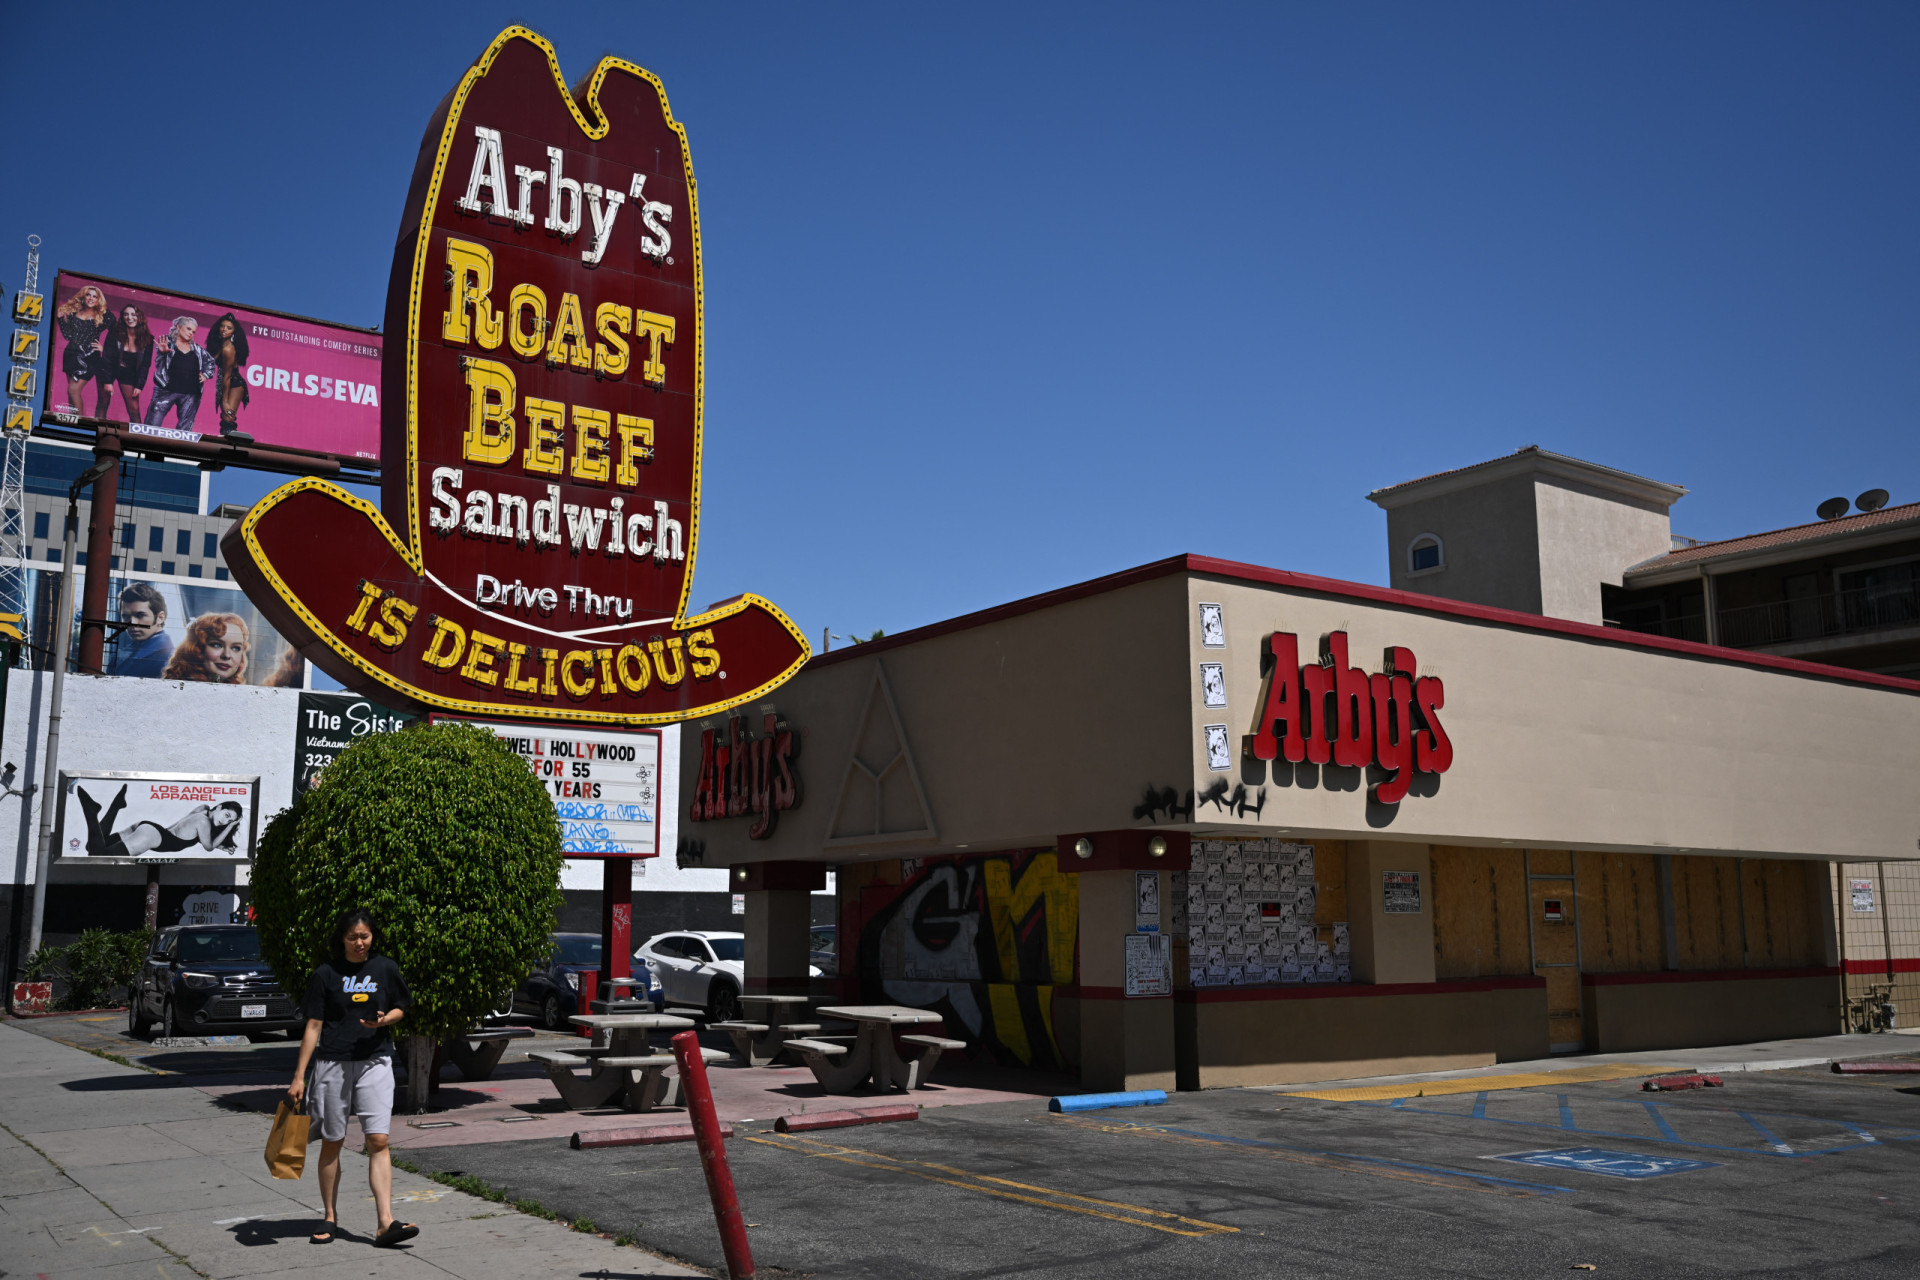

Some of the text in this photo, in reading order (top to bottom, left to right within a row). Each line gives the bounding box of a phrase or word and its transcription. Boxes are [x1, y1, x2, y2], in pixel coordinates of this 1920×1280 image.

[458, 125, 673, 264] Arby's
[442, 237, 676, 384] ROAST
[252, 325, 378, 357] FYC OUTSTANDING COMEDY SERIES
[6, 294, 43, 431] KTLA
[246, 364, 379, 408] GIRLS5EVA
[58, 413, 77, 423] 3577
[463, 356, 655, 486] BEEF
[131, 424, 198, 441] OUTFRONT
[355, 451, 377, 460] NETFLIX
[428, 466, 685, 562] Sandwich
[475, 573, 633, 619] Drive Thru
[345, 580, 722, 697] IS DELICIOUS
[305, 709, 342, 731] The
[1246, 630, 1454, 804] Arby's
[305, 735, 351, 749] Vietname
[498, 736, 636, 762] WELL HOLLYWOOD
[533, 758, 591, 778] FOR 55
[689, 712, 796, 841] Arby's
[149, 792, 217, 802] APPAREL
[150, 784, 247, 796] LOS ANGELES
[554, 779, 602, 799] YEARS
[192, 902, 220, 914] DRIVE
[342, 974, 379, 993] Ucla
